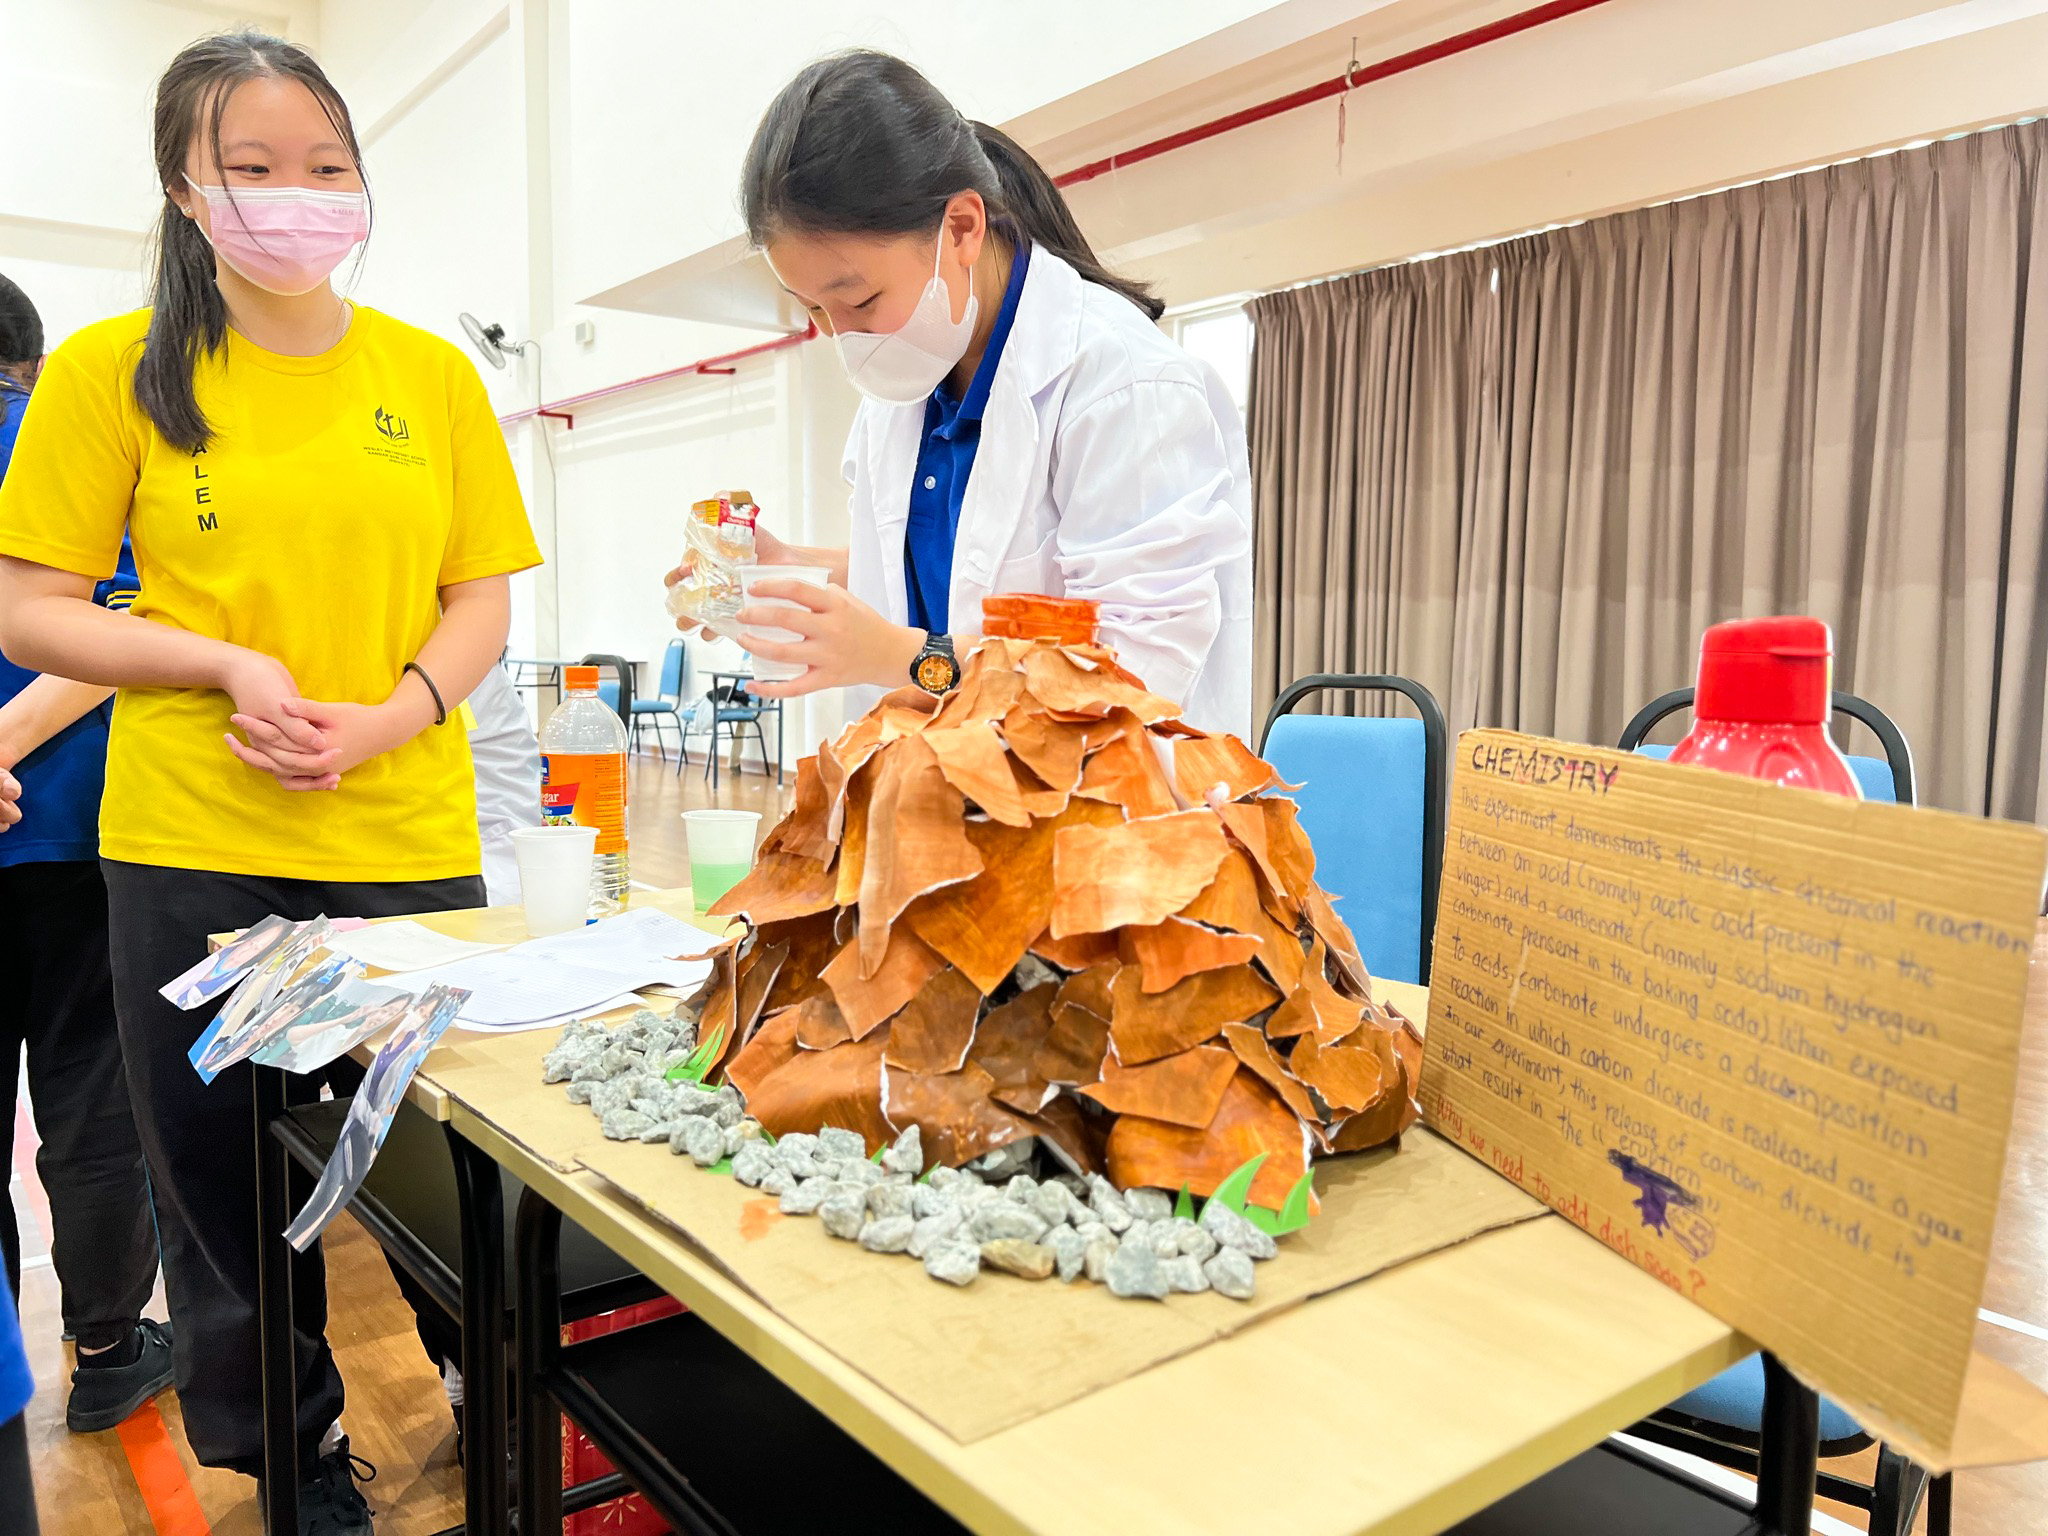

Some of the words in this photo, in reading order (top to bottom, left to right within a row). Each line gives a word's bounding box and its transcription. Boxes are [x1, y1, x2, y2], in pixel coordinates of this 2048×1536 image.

[1472, 744, 1618, 797] CHEMISTRY
[1459, 827, 1506, 862] between
[1514, 852, 1531, 873] an
[1539, 858, 1571, 887] acid
[1651, 893, 1701, 924] acetic
[1711, 909, 1755, 941] acid
[1763, 925, 1842, 965] present
[1855, 952, 1876, 971] in
[1897, 950, 1935, 988] the
[1462, 786, 1478, 811] This
[1485, 795, 1557, 836] experiment
[1676, 845, 1702, 875] the
[1915, 910, 2031, 955] reaction
[1452, 927, 1466, 961] to
[1519, 970, 1598, 1018] carbonate
[1613, 1005, 1705, 1063] undergoes
[1719, 1054, 1732, 1075] a
[1453, 899, 1513, 936] carbonate
[1589, 954, 1600, 972] in
[1611, 955, 1632, 985] the
[1644, 966, 1699, 1020] baking
[1850, 1055, 1958, 1114] exposed
[1505, 884, 1529, 908] and
[1538, 900, 1547, 913] a
[1557, 904, 1634, 944] carbonate
[1735, 961, 1809, 1005] sodium
[1825, 985, 1939, 1046] hydrogen
[1442, 1041, 1472, 1071] what
[1482, 1068, 1523, 1102] result
[1530, 1092, 1543, 1119] in
[1556, 1105, 1583, 1147] the
[1444, 1005, 1460, 1026] In
[1464, 1021, 1485, 1040] our
[1570, 1076, 1597, 1111] this
[1605, 1103, 1658, 1150] release
[1667, 1132, 1689, 1156] of
[1700, 1151, 1765, 1196] carbon
[1780, 1185, 1872, 1251] dioxide
[1893, 1244, 1916, 1277] is
[1450, 976, 1499, 1015] reaction
[1506, 1006, 1519, 1030] in
[1528, 1019, 1571, 1057] which
[1580, 1049, 1633, 1081] carbon
[1645, 1068, 1710, 1122] dioxide
[1722, 1114, 1735, 1133] is
[1849, 1176, 1876, 1203] as
[1892, 1196, 1909, 1218] a
[1913, 1211, 1964, 1247] gas
[1437, 1093, 1462, 1140] Why
[1469, 1128, 1485, 1156] we
[1493, 1146, 1524, 1184] need
[1531, 1171, 1551, 1202] to
[1556, 1194, 1589, 1229] add
[1600, 1216, 1638, 1263] dish
